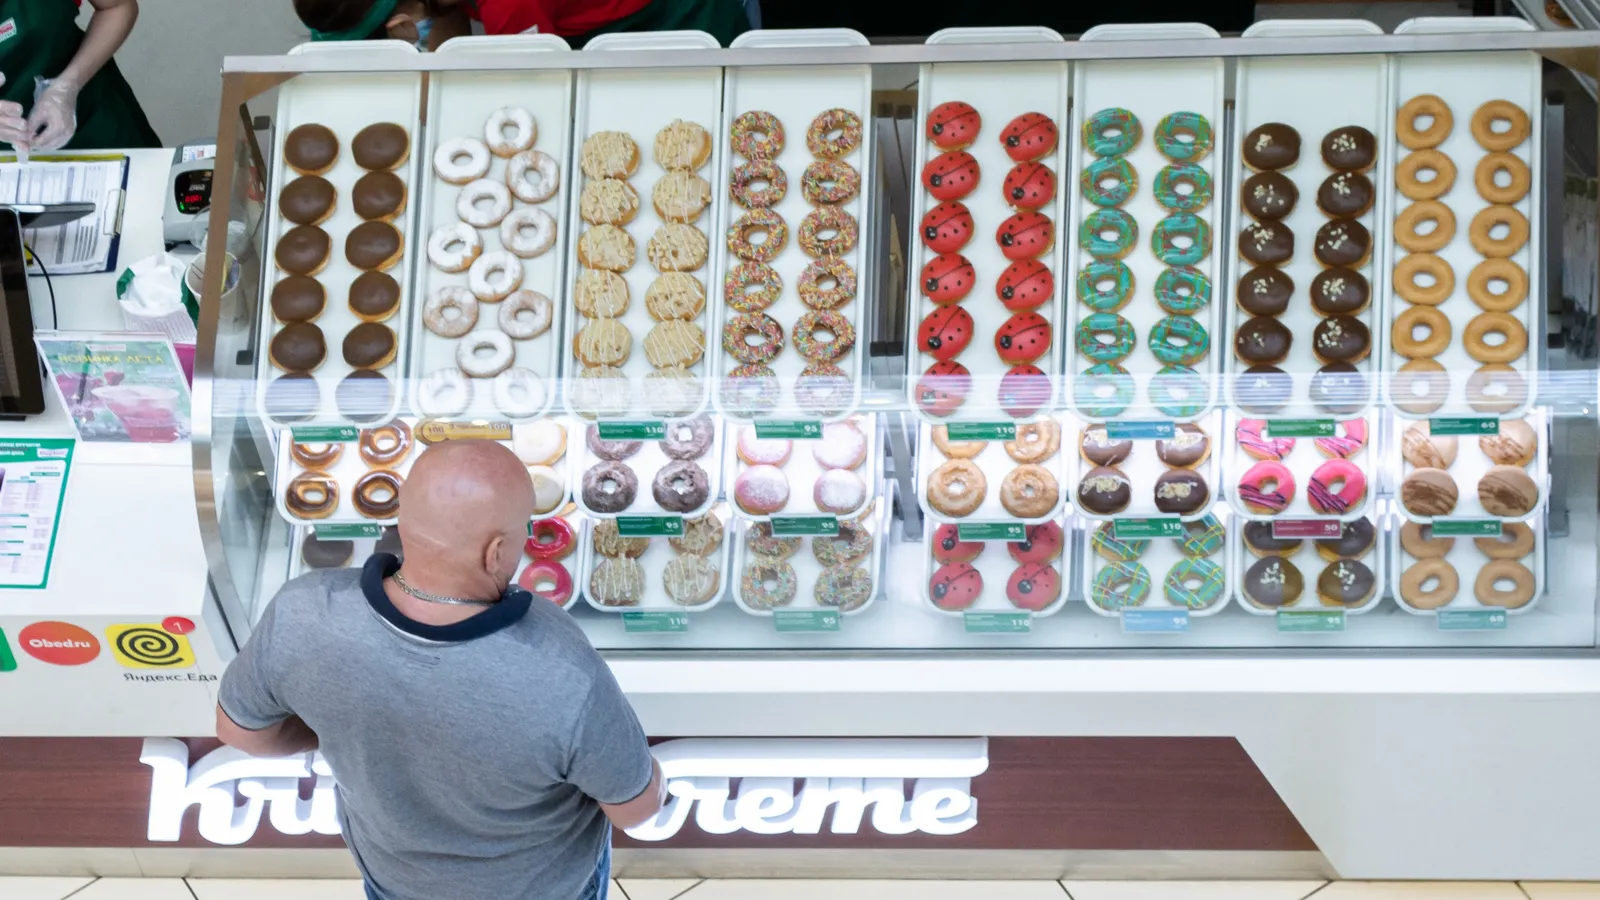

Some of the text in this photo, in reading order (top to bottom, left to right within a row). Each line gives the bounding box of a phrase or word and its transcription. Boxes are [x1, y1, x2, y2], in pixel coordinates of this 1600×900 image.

[126, 355, 164, 364] ЛЕТА
[804, 424, 818, 432] 95
[670, 617, 688, 625] 110
[172, 621, 182, 632] 1
[28, 638, 91, 648] Obed.ru
[123, 672, 218, 683] Яндекс.Еда
[139, 737, 342, 845] Kri
